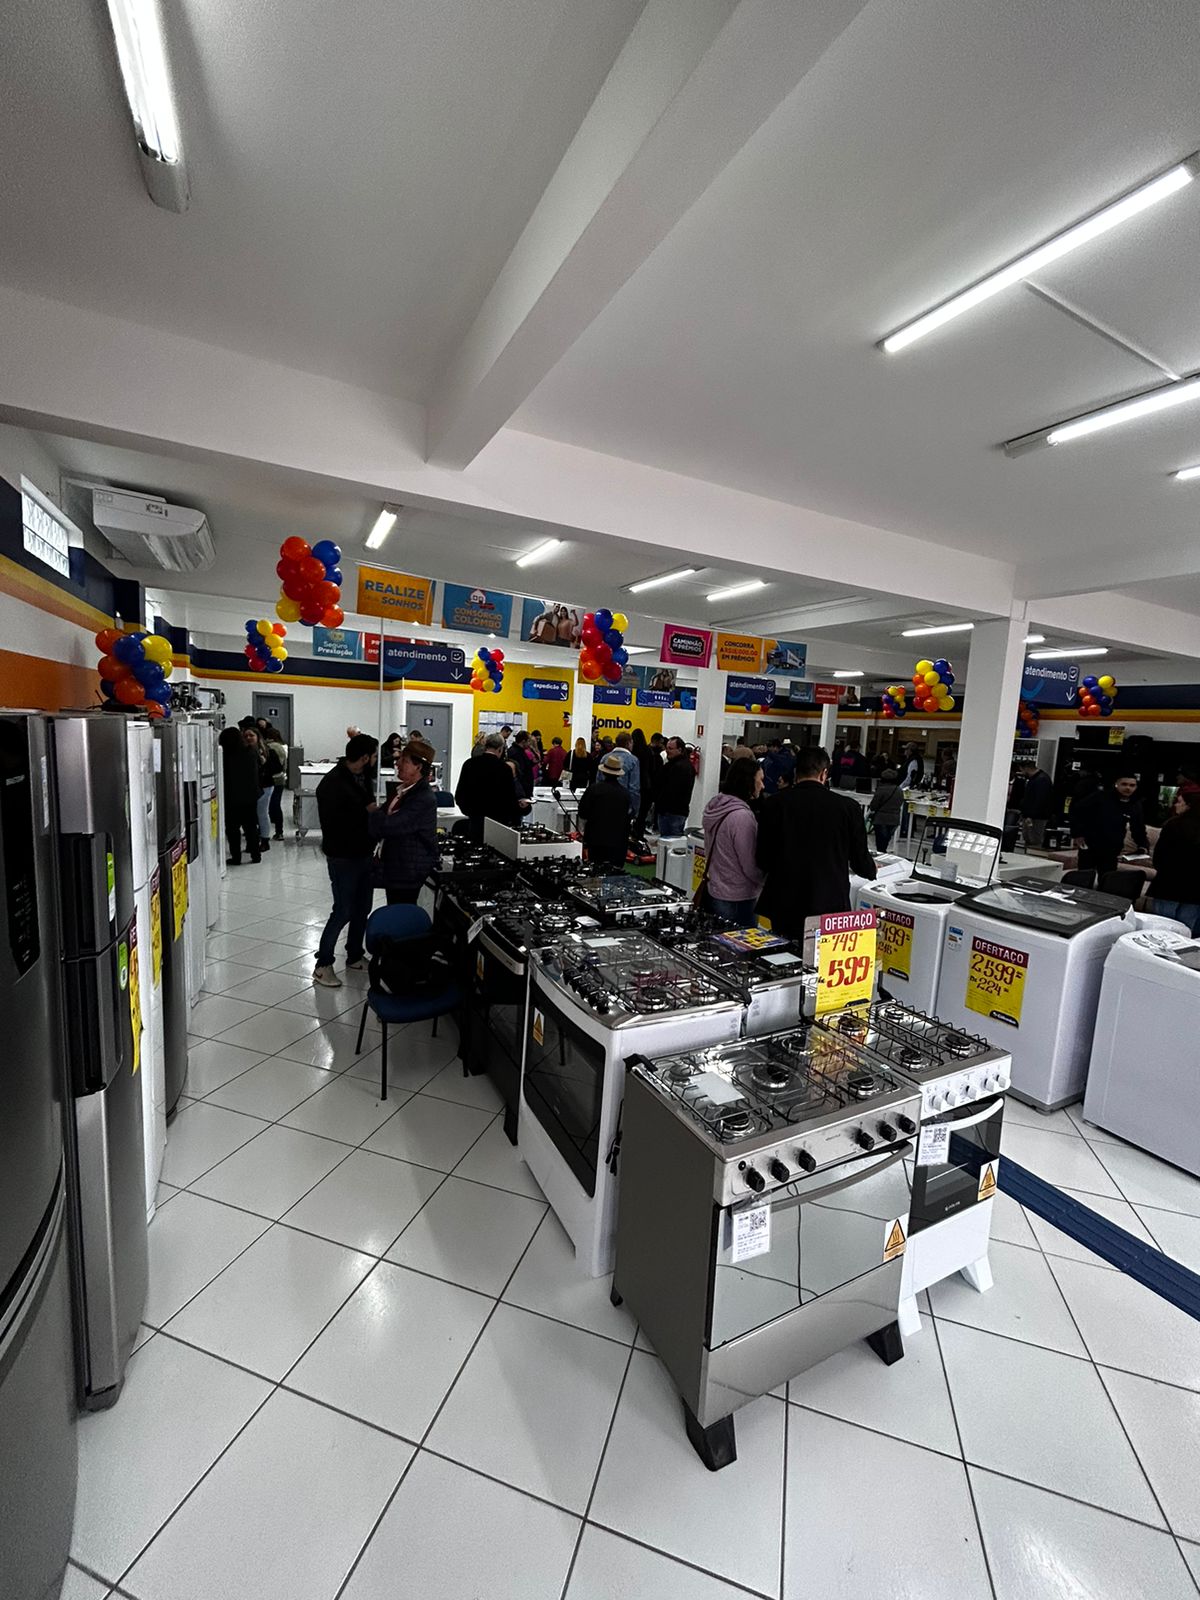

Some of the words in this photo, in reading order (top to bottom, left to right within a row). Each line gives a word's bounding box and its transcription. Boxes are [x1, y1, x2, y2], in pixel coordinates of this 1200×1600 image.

[365, 580, 425, 600] REALIZE
[381, 596, 424, 610] SONHOS
[453, 615, 502, 629] COLOMBO
[317, 646, 353, 656] Prestação
[323, 641, 348, 650] Seguro
[724, 640, 755, 649] CONCORRA
[387, 648, 448, 662] atendimento
[1025, 666, 1068, 680] atendimento
[729, 681, 765, 691] atendimento
[592, 715, 632, 729] lombo
[825, 912, 873, 931] OFERTAÇO
[975, 940, 1024, 964] OFERTAÇO
[826, 956, 871, 989] 599
[976, 977, 1001, 996] 224
